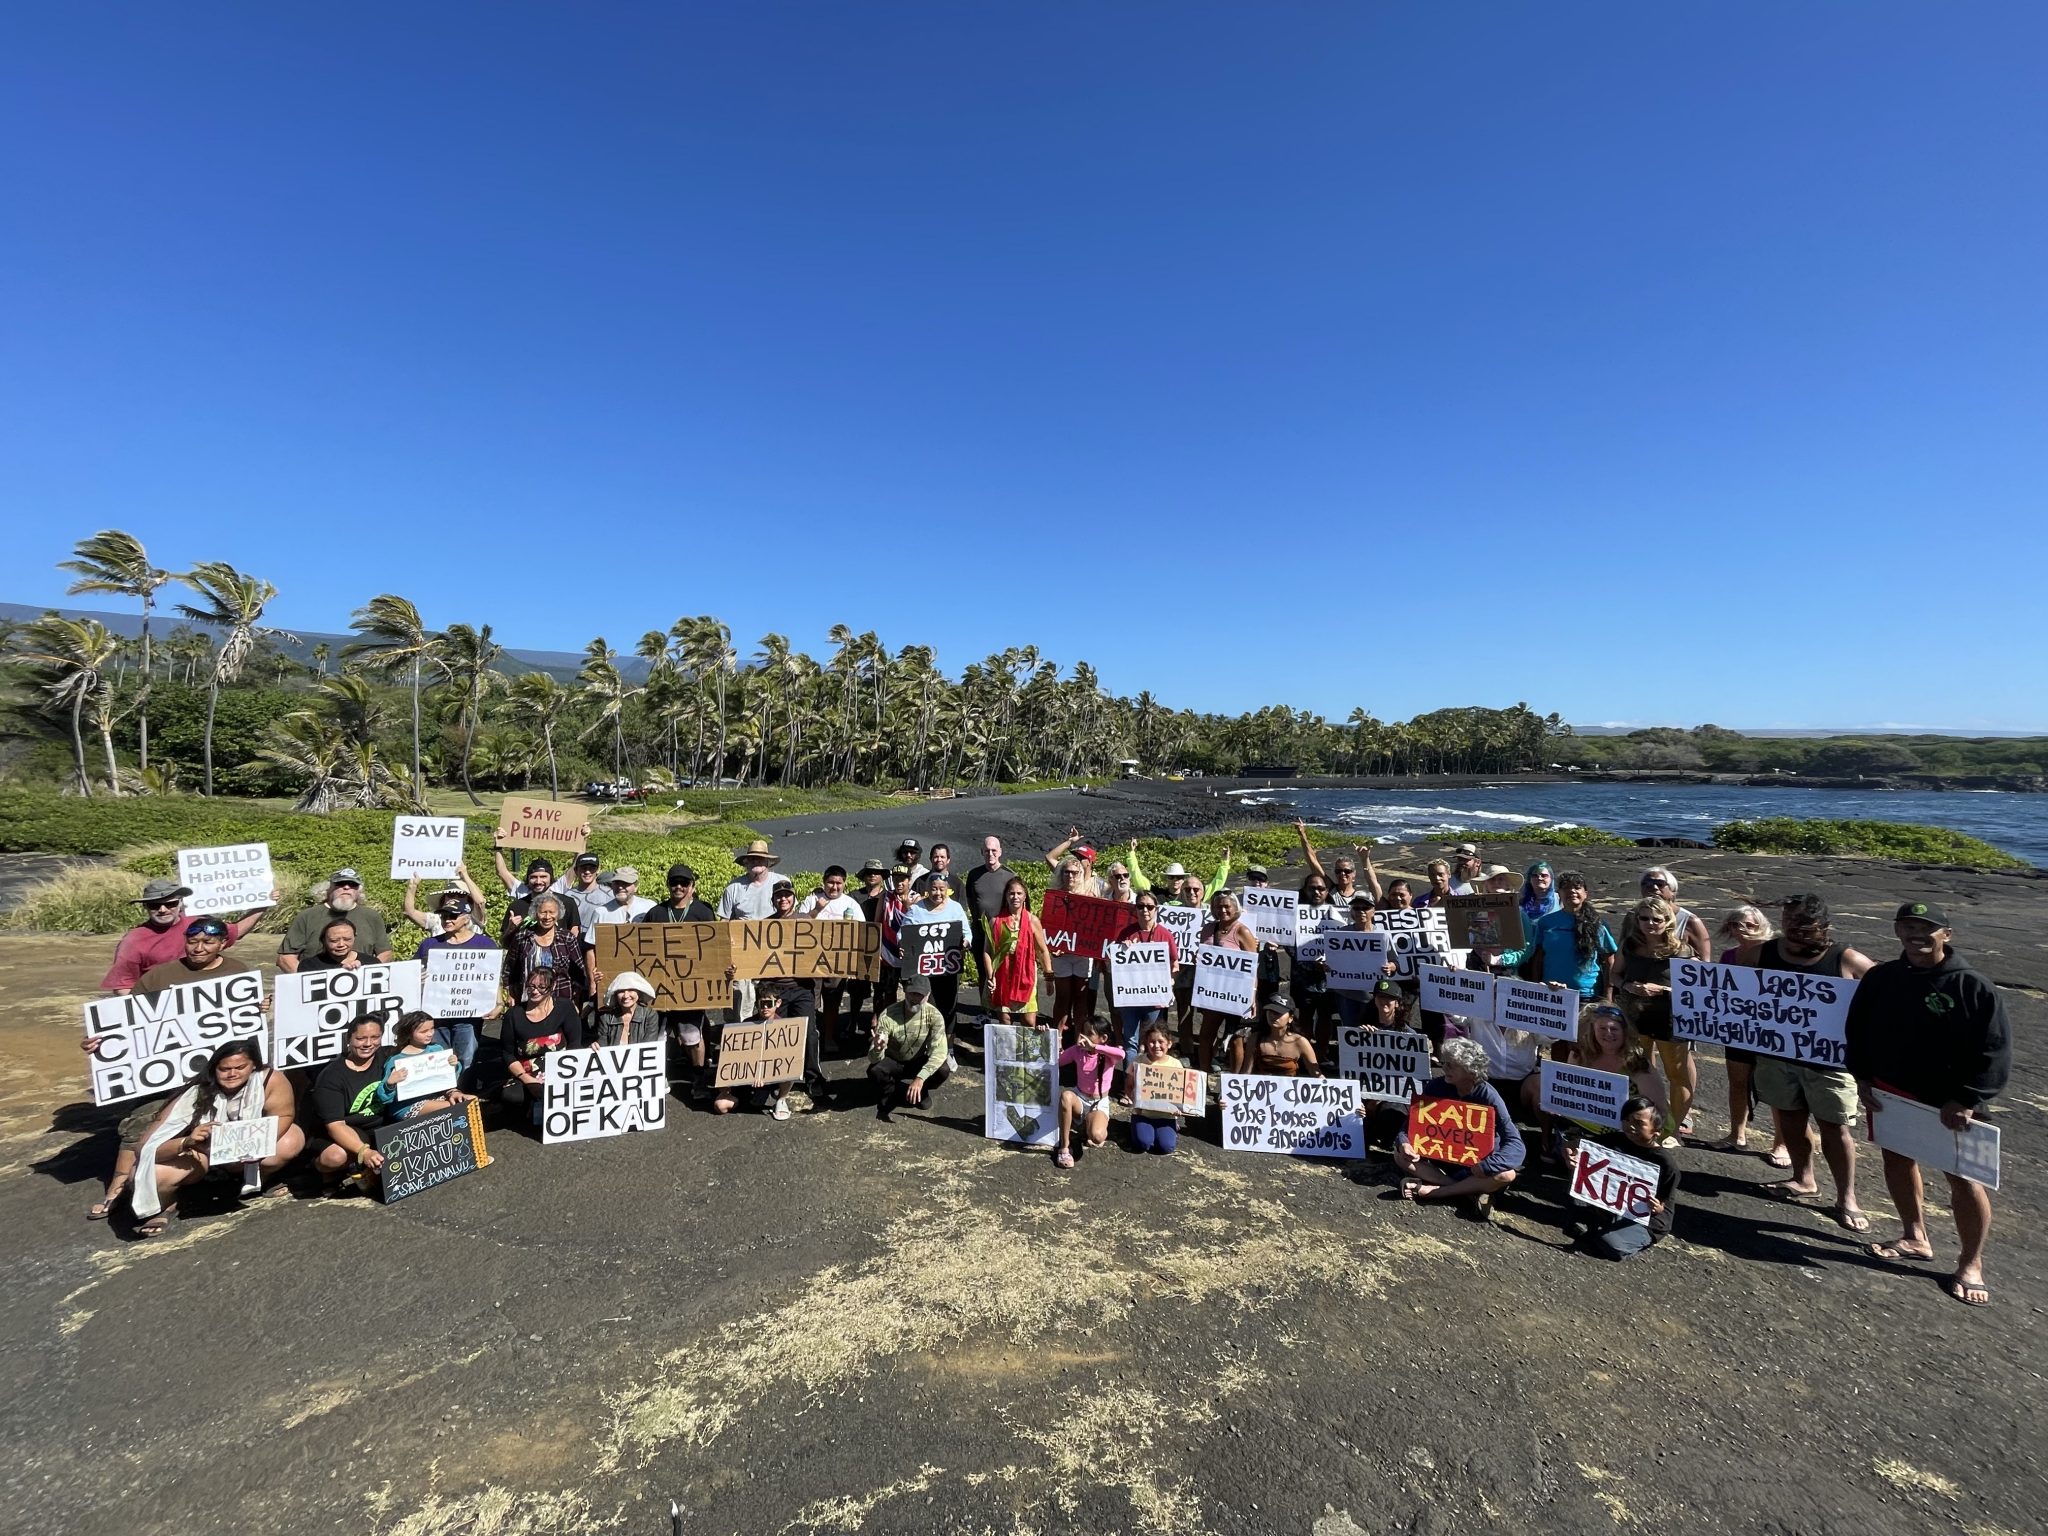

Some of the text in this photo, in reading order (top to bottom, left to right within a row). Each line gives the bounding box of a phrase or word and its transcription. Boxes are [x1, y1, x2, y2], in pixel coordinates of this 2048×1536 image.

[400, 824, 459, 838] SAVE
[186, 849, 262, 868] BUILD
[398, 858, 457, 868] Punalu'u
[188, 867, 265, 884] Habitats
[216, 882, 244, 893] NOT
[194, 892, 268, 909] CONDOS
[1247, 893, 1294, 910] SAVE
[1156, 907, 1196, 931] Keep
[1300, 910, 1334, 920] BUIL
[1374, 908, 1448, 930] RESPE
[743, 920, 880, 954] NO BUILD
[919, 922, 950, 938] GET
[1042, 928, 1077, 952] WAI
[1256, 926, 1292, 936] nalu'u
[614, 924, 716, 962] KEEP
[923, 940, 944, 953] AN
[1302, 948, 1324, 956] CON
[1329, 938, 1382, 952] SAVE
[446, 952, 486, 960] FOLLOW
[759, 951, 804, 975] AT
[918, 949, 960, 976] EIS
[1115, 950, 1166, 964] SAVE
[1201, 952, 1252, 973] SAVE
[302, 966, 390, 1004] FOR
[432, 973, 495, 982] GUIDELINES
[1330, 970, 1384, 980] Punalu'u
[1428, 973, 1485, 990] Avoid Maui
[1678, 964, 1738, 992] SMA
[1117, 985, 1168, 994] Punalu'u
[1197, 986, 1249, 1004] Punalu'u
[1438, 988, 1474, 1003] Repeat
[1511, 988, 1563, 1004] REQUIRE AN
[90, 976, 258, 1034] LIVING
[440, 1008, 477, 1017] Country!
[1507, 999, 1566, 1018] Environment
[1681, 990, 1817, 1028] a disaster
[1506, 1010, 1567, 1032] Impact Study
[1674, 1011, 1786, 1052] mitigation
[722, 1031, 762, 1052] KEEP
[1344, 1030, 1429, 1053] CRITICAL
[96, 1042, 228, 1102] ROO
[557, 1046, 657, 1079] SAVE
[720, 1056, 795, 1081] COUNTRY
[1358, 1052, 1415, 1073] HONU
[548, 1073, 663, 1109] HEART
[1556, 1070, 1612, 1091] REQUIRE AN
[1226, 1079, 1354, 1111] Stop dozing
[1552, 1083, 1616, 1105] Environment
[1231, 1102, 1345, 1128] the bones of
[1551, 1096, 1617, 1120] Impact Study
[546, 1110, 591, 1136] OF
[405, 1118, 453, 1153] KAPU
[1231, 1126, 1352, 1150] our ancestors
[1426, 1125, 1474, 1146] OVER
[399, 1177, 425, 1196] SAVE
